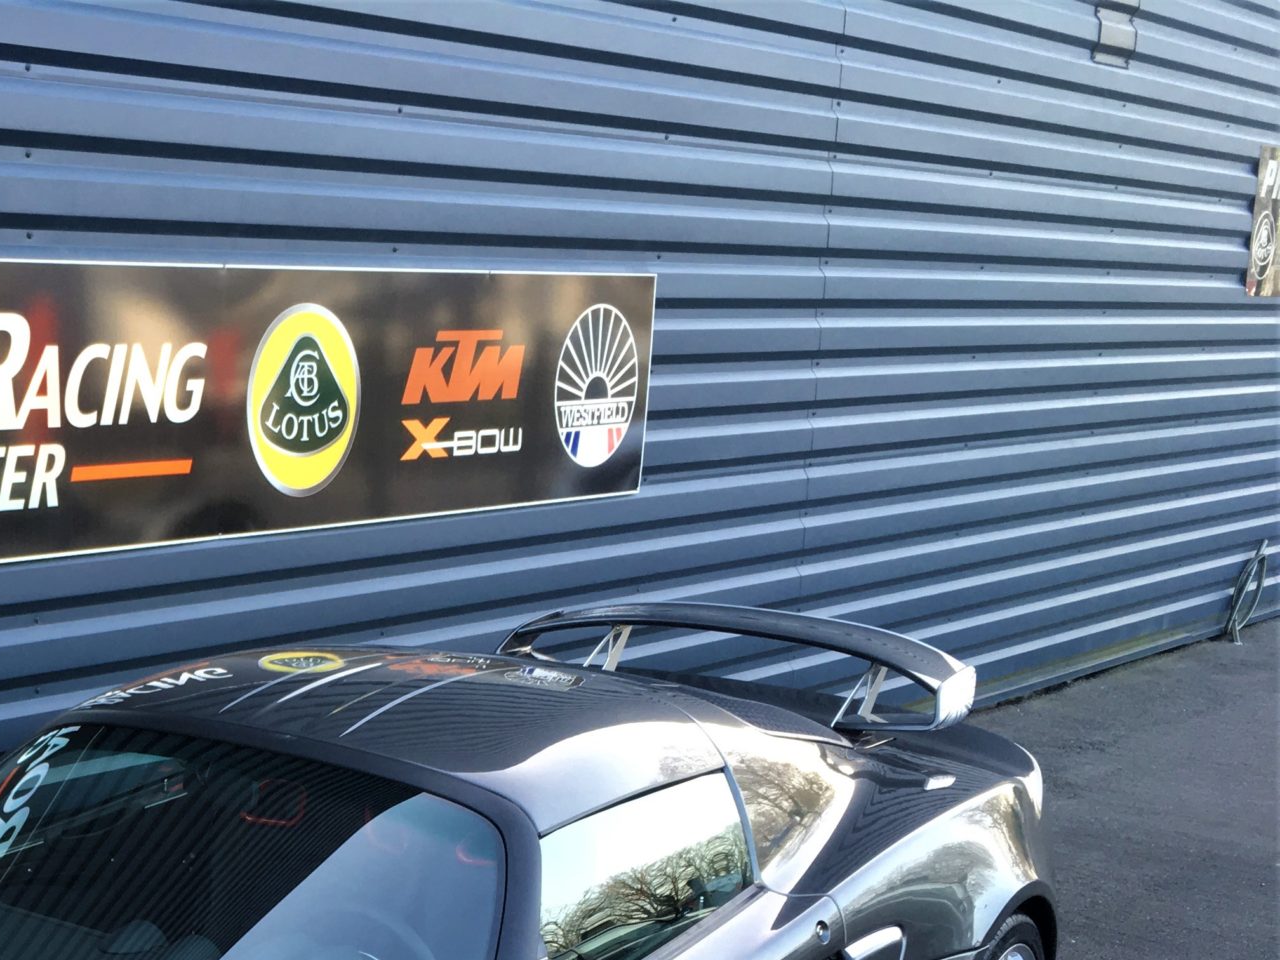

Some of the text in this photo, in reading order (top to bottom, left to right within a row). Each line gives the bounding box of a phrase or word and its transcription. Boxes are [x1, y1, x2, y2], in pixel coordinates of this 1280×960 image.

[401, 329, 525, 405] KTM
[265, 400, 343, 442] LOTUS
[560, 402, 628, 428] WESTFIELD
